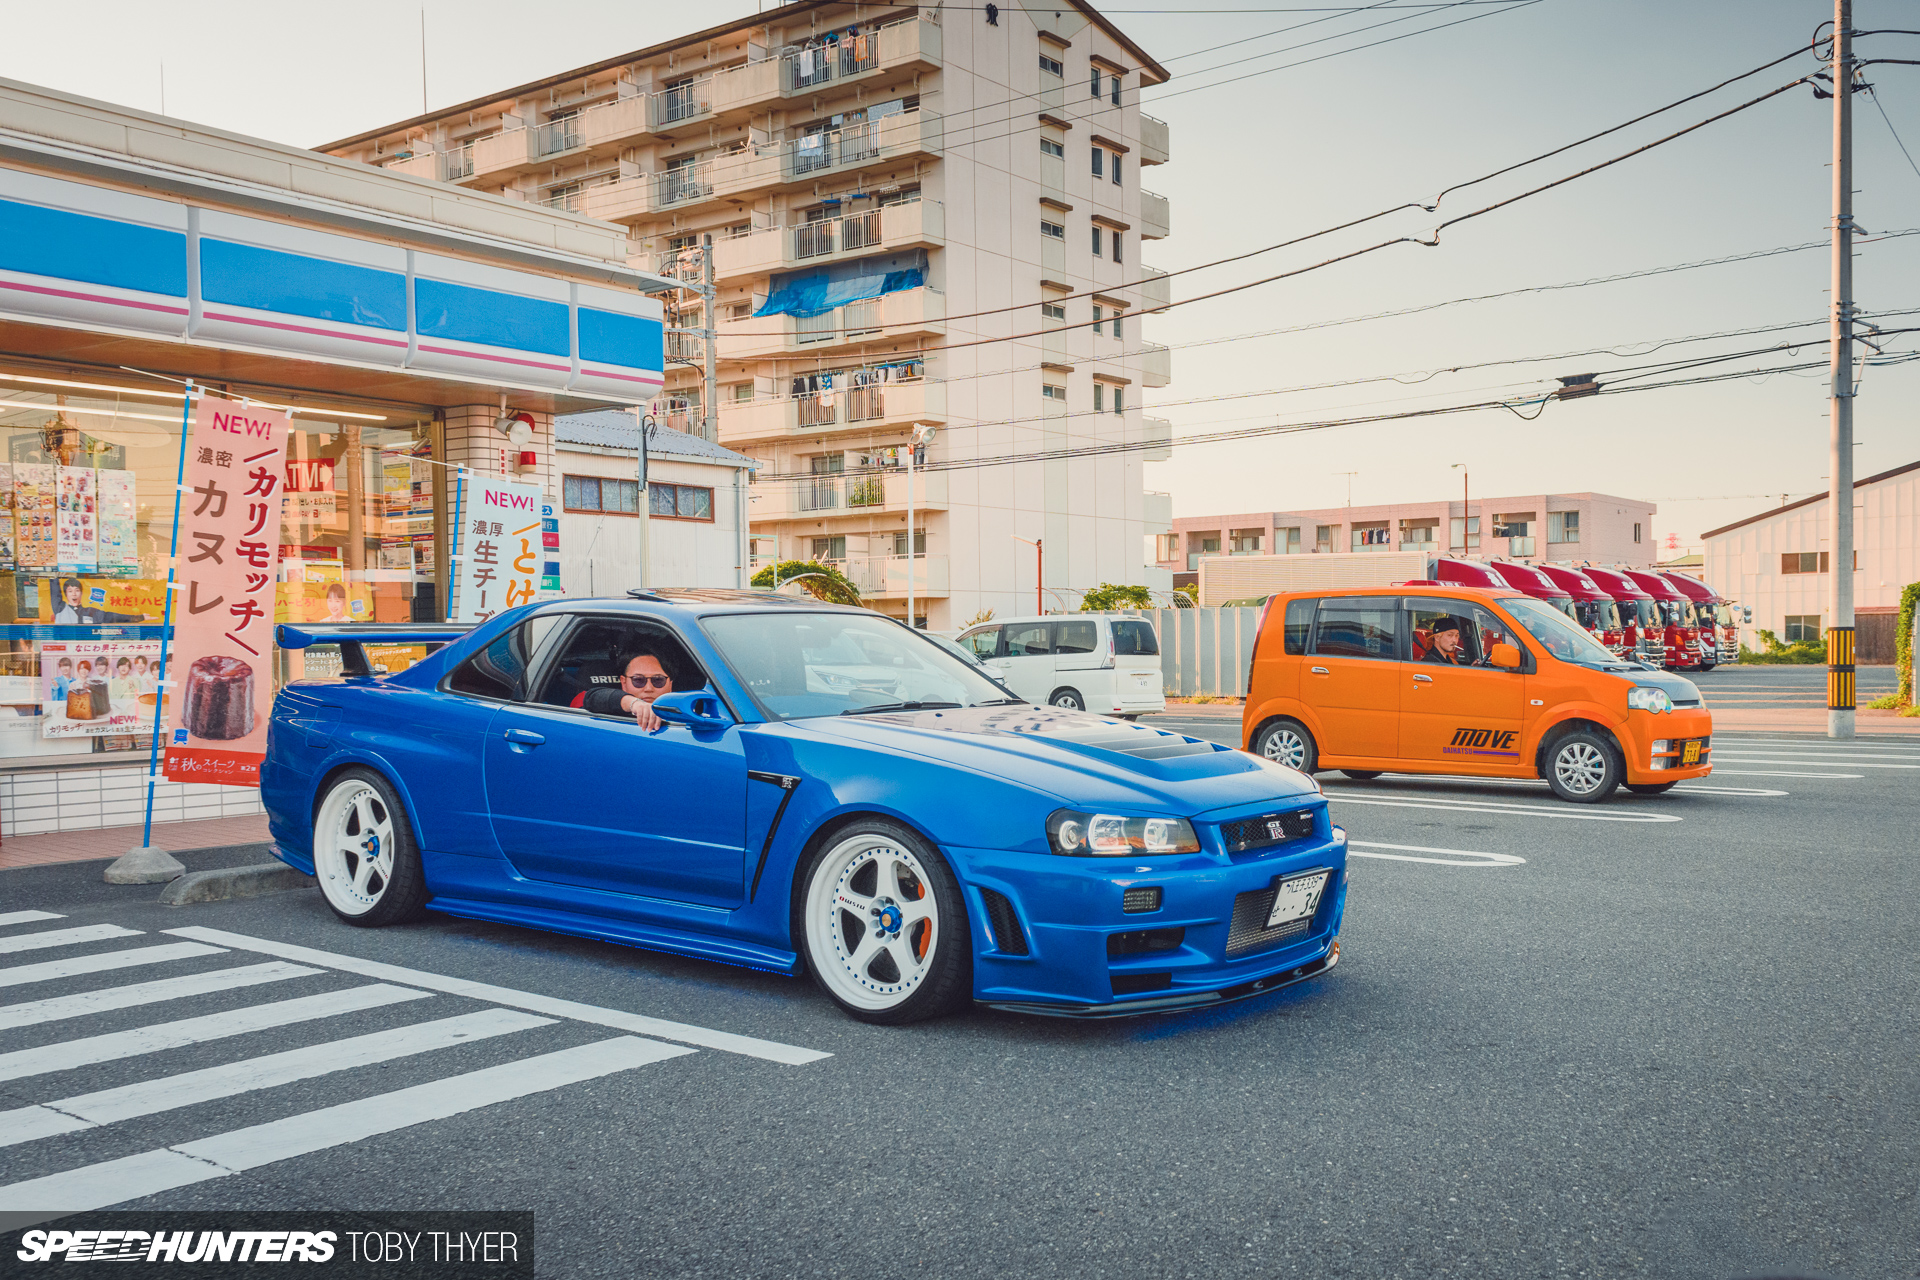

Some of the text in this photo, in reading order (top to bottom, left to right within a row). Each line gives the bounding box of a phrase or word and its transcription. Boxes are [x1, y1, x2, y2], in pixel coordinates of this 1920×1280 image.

[212, 411, 271, 440] NEW!
[197, 446, 233, 468] 濃密
[485, 489, 534, 512] NEW!
[472, 520, 504, 537] 濃厚
[188, 479, 228, 615] カヌレ
[229, 466, 279, 632] カリモッチ
[506, 538, 537, 608] とけ
[109, 716, 138, 725] NEW!
[1450, 727, 1520, 749] MOVE
[1443, 747, 1473, 755] DAIHATSU
[203, 758, 235, 769] スイーツ
[1299, 889, 1321, 916] 34
